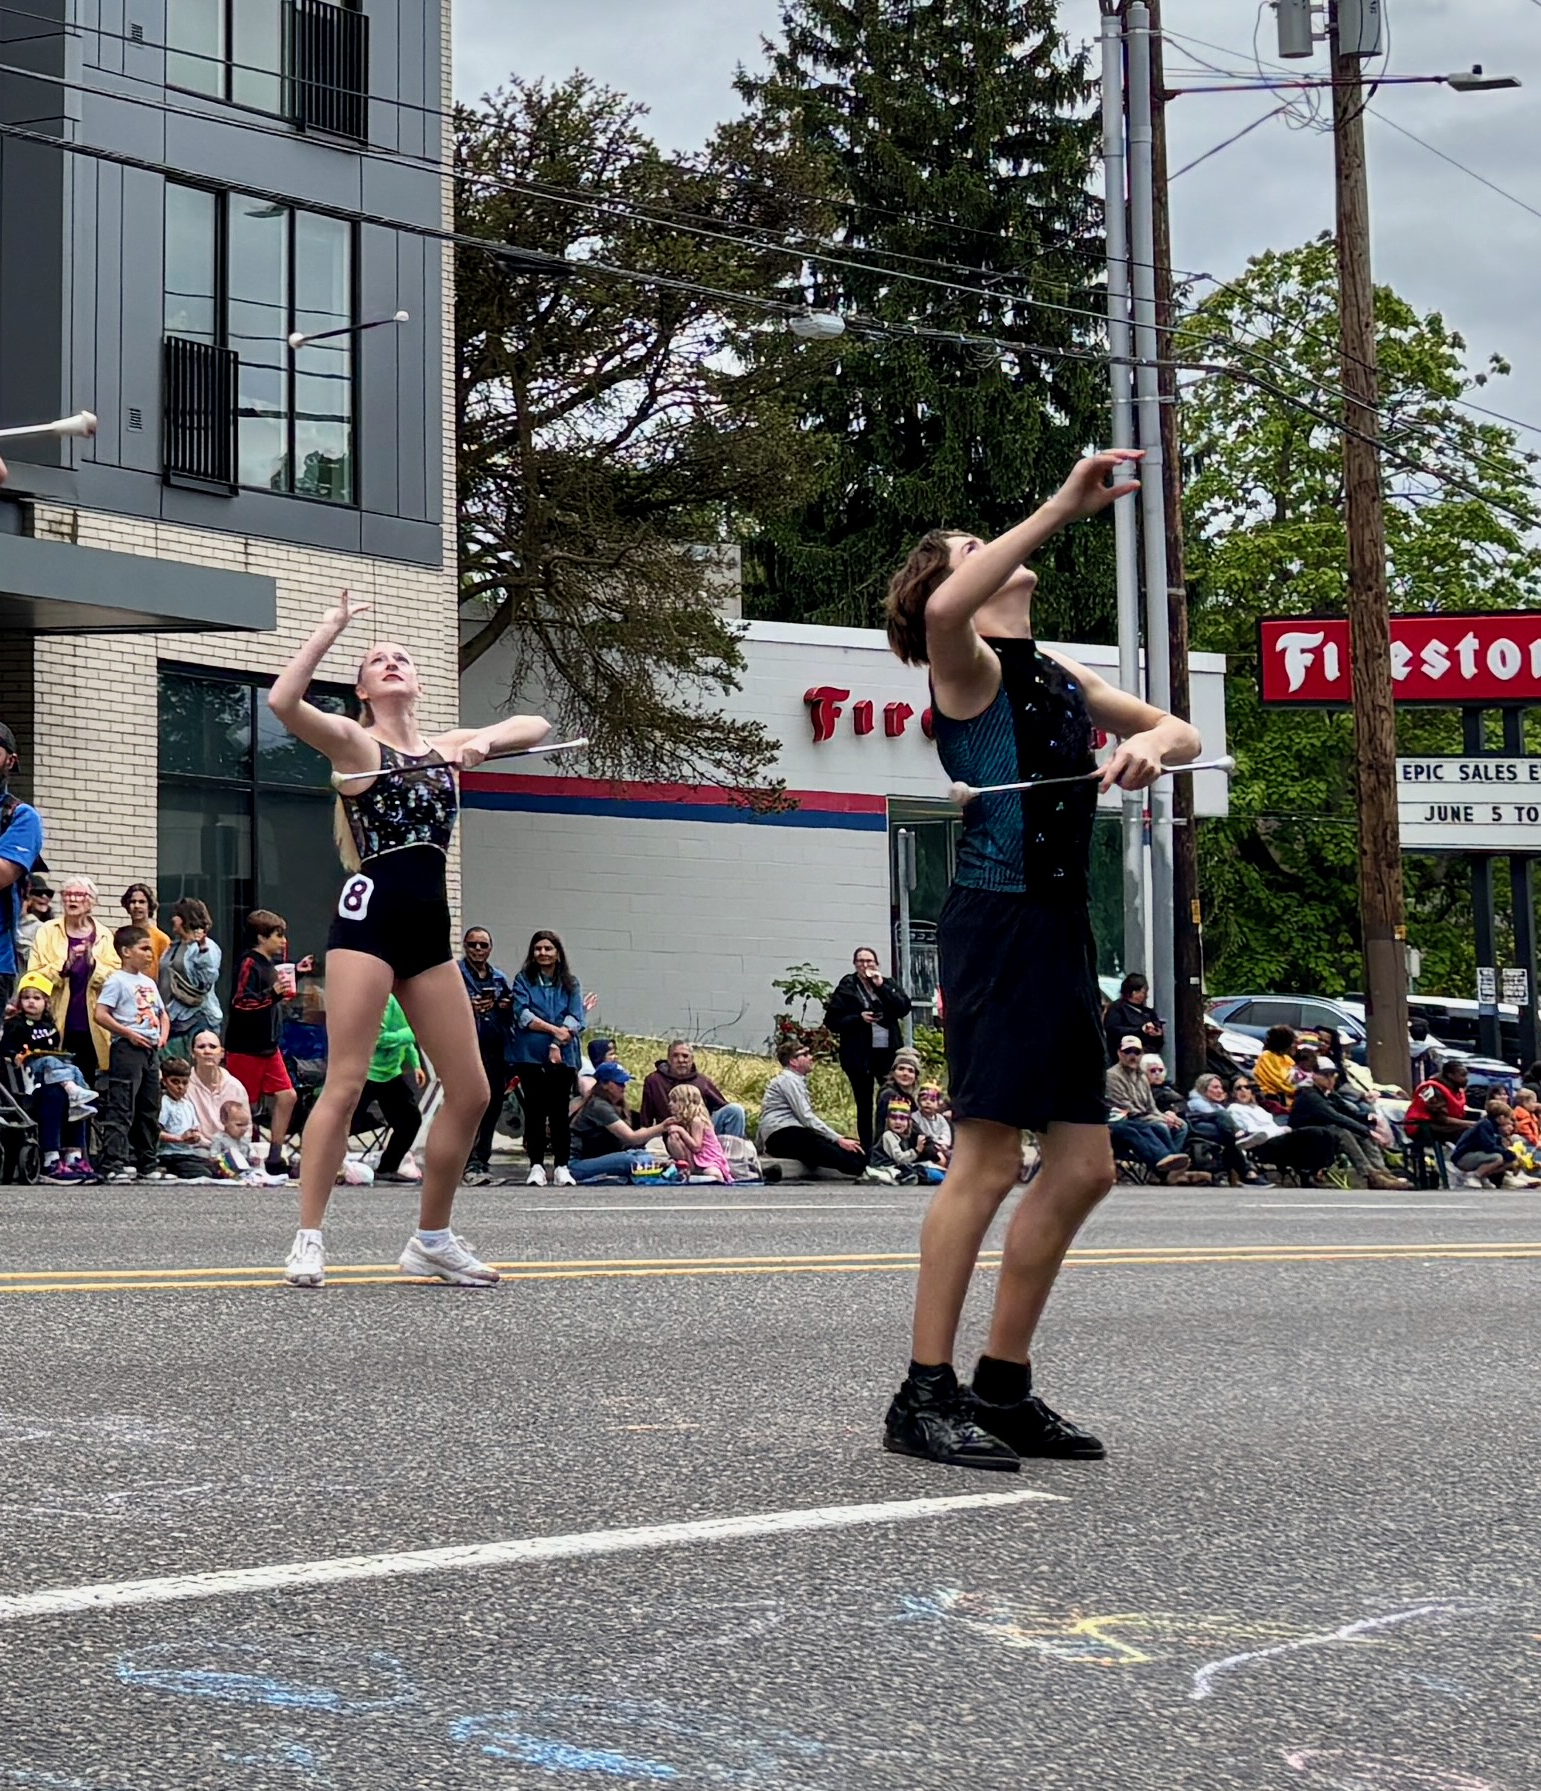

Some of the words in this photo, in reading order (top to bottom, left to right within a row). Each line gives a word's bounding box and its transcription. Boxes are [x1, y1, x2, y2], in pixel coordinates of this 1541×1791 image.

[1275, 631, 1541, 694] Fiesto
[1402, 764, 1444, 781] EPIC
[1459, 764, 1518, 781] SALES
[1528, 764, 1541, 781] E
[1424, 805, 1474, 822] JUNE
[1491, 806, 1503, 822] 5
[1514, 806, 1540, 823] TO
[343, 879, 368, 912] 8
